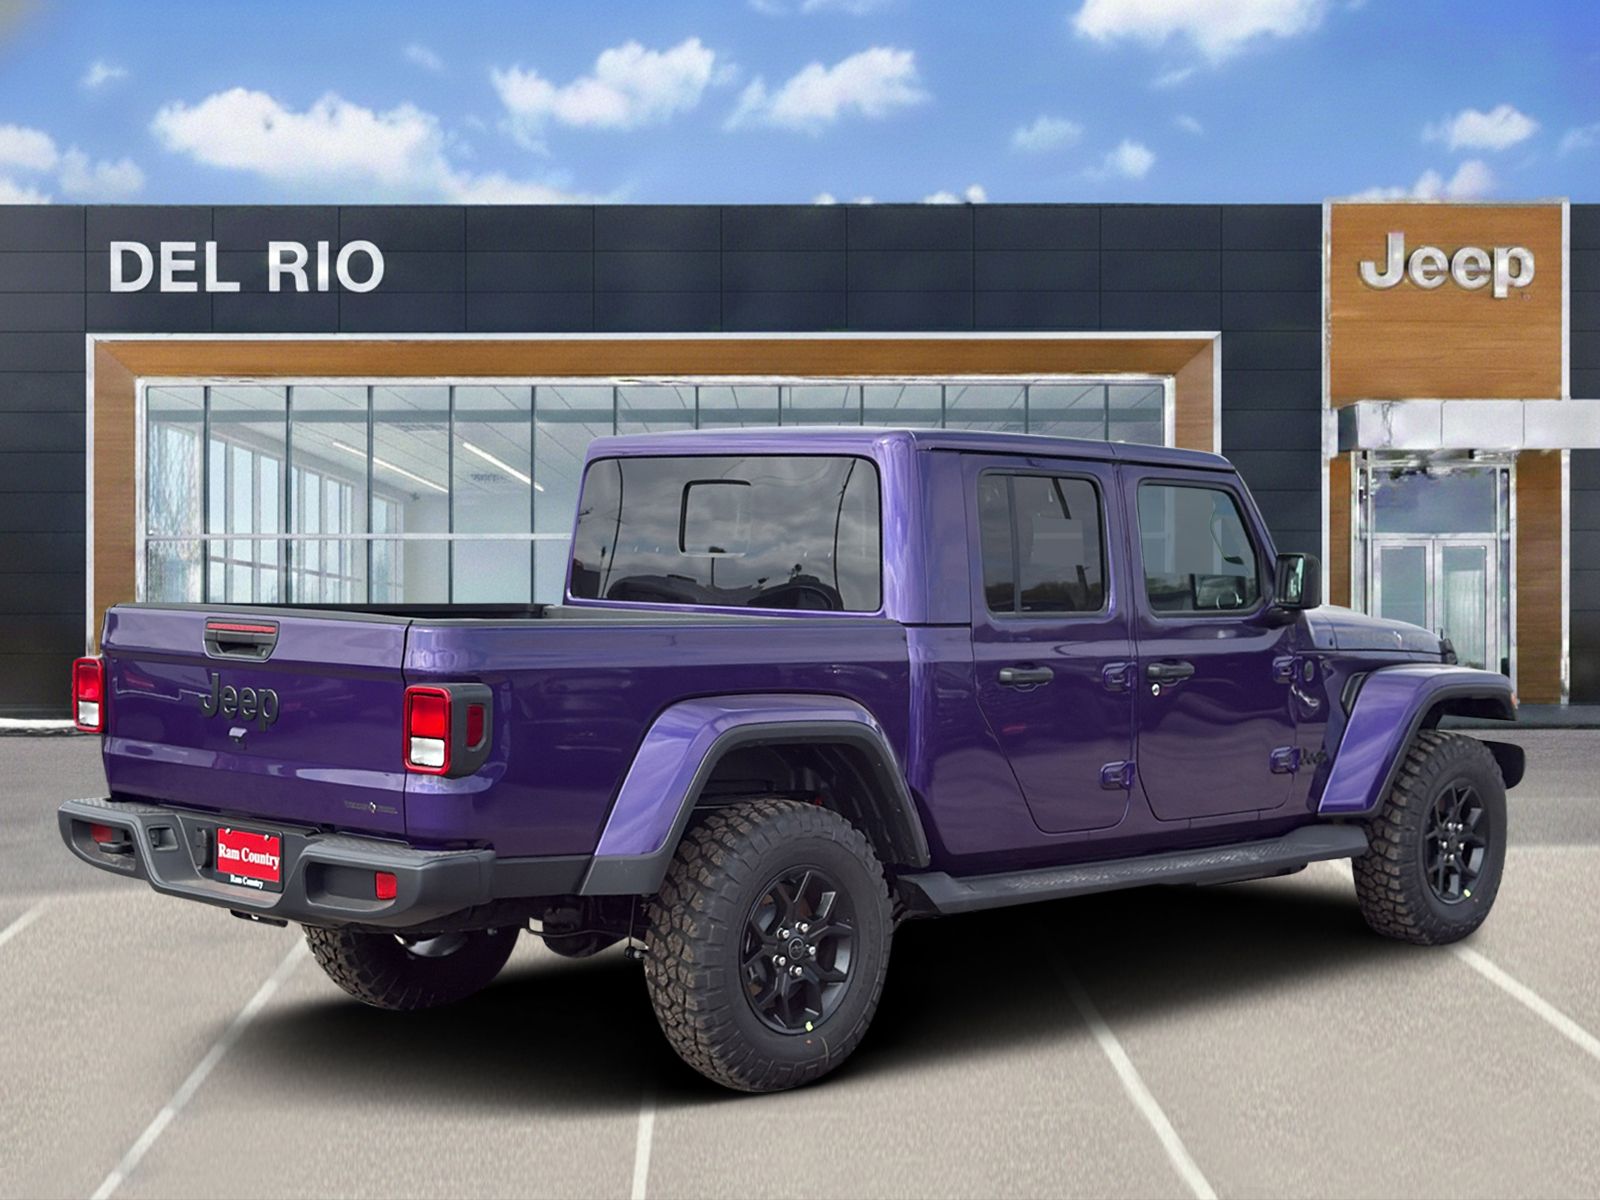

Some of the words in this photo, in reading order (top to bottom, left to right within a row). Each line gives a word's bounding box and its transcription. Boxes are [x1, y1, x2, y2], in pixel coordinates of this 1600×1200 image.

[110, 241, 240, 292] DEL
[268, 240, 385, 293] RIO
[1359, 231, 1535, 298] Jeep
[199, 672, 279, 732] Jeep
[218, 843, 240, 860] Ram
[241, 847, 280, 870] Country
